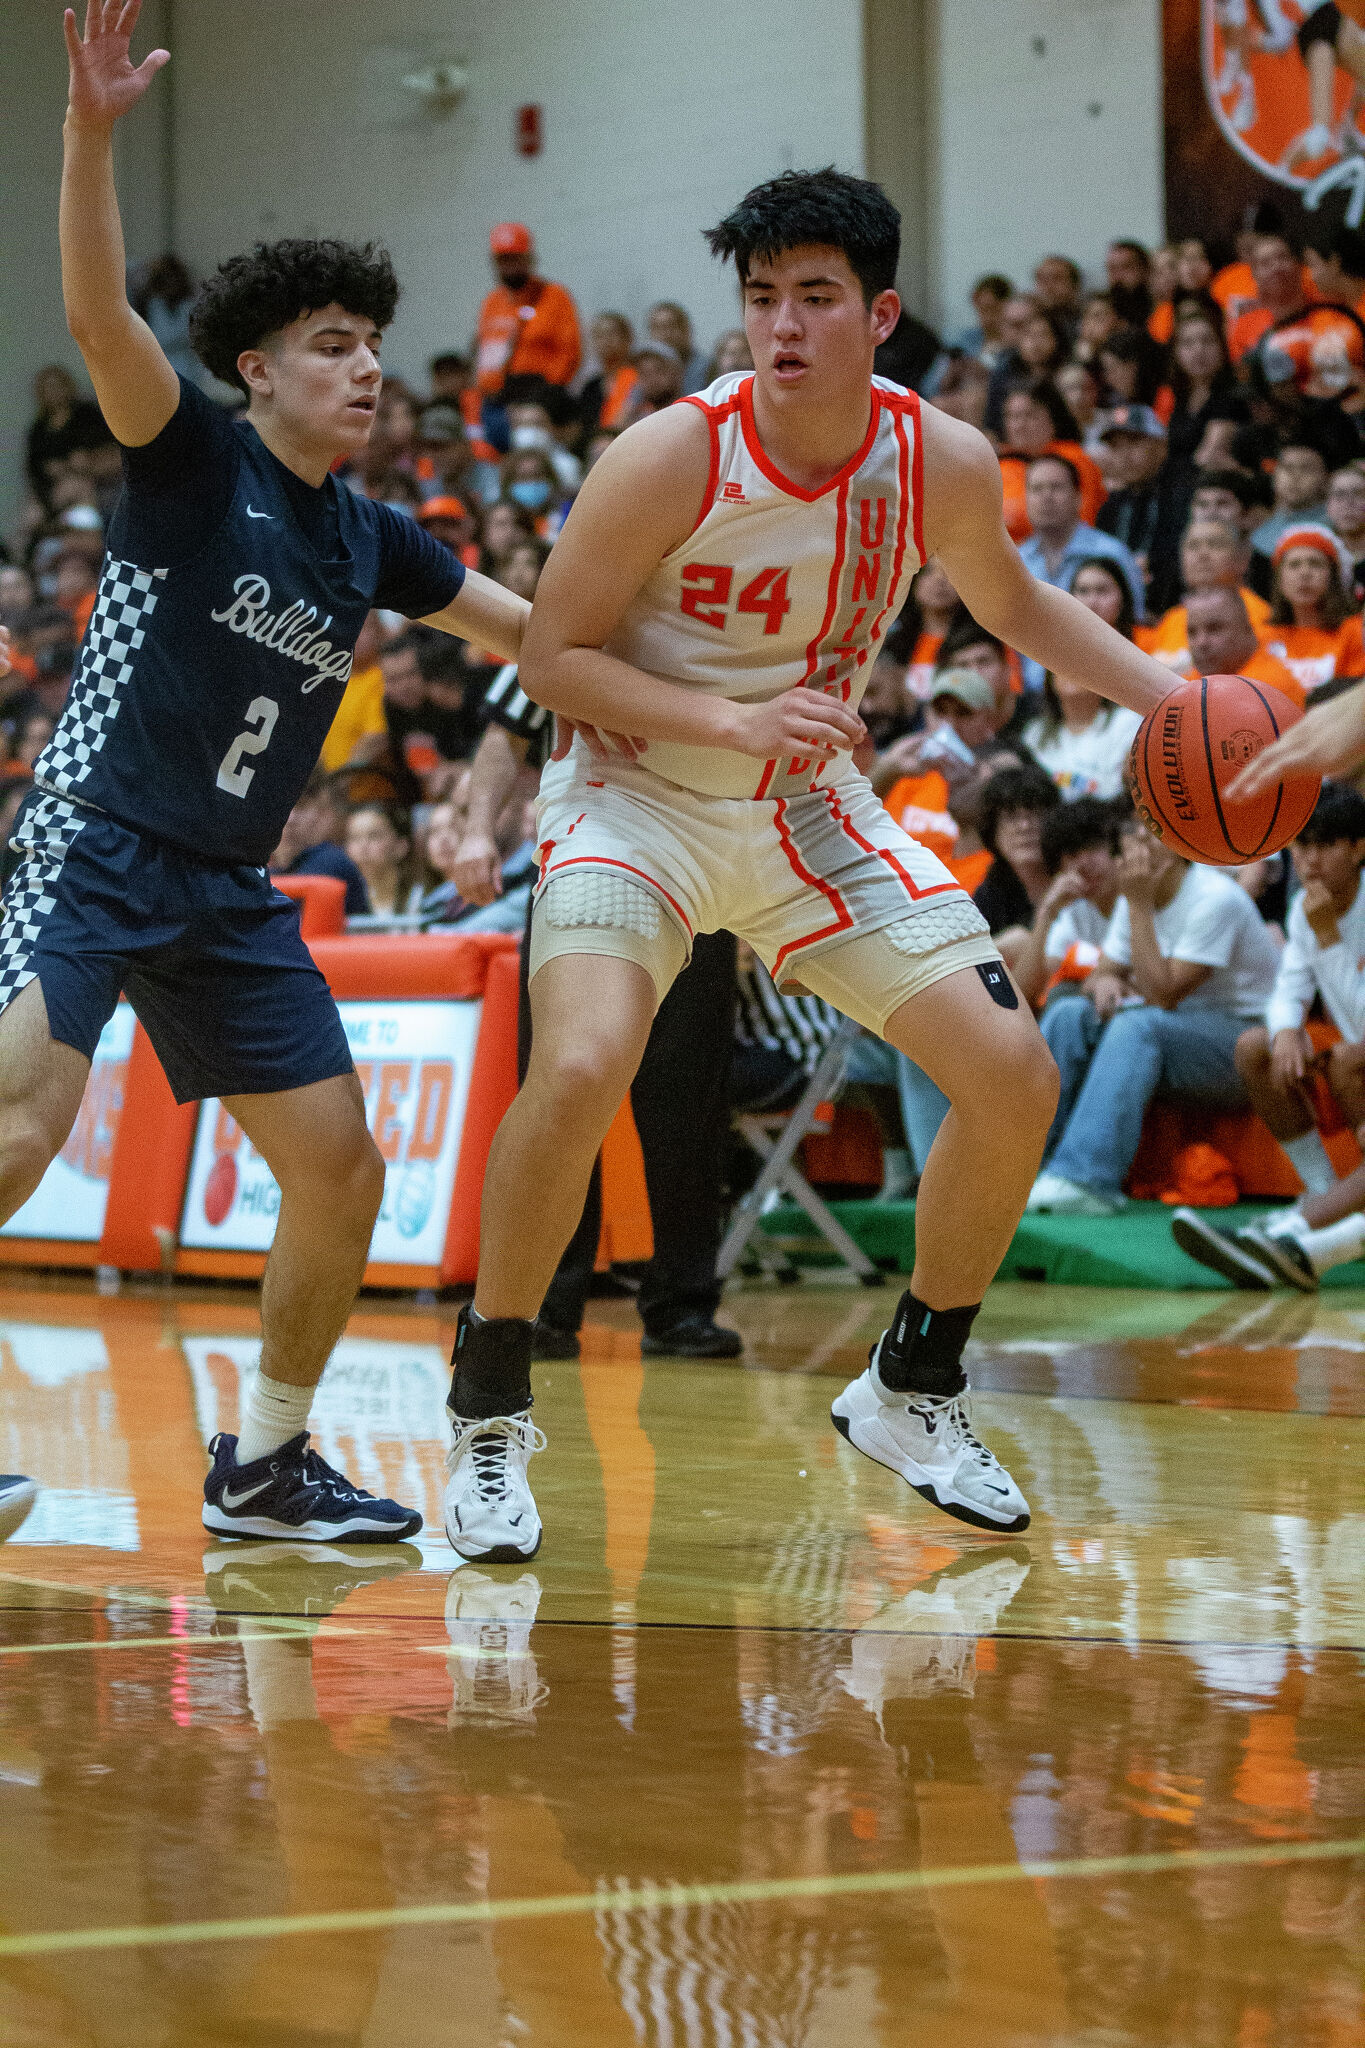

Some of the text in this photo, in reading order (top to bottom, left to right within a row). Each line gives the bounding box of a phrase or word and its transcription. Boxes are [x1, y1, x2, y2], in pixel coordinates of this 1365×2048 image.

[211, 573, 353, 694] Bulldogs
[680, 562, 792, 635] 24
[786, 497, 887, 776] UNITD
[216, 696, 280, 799] 2
[1162, 706, 1196, 822] EVOLUTION
[989, 972, 1001, 984] KT
[239, 1179, 284, 1217] HIG
